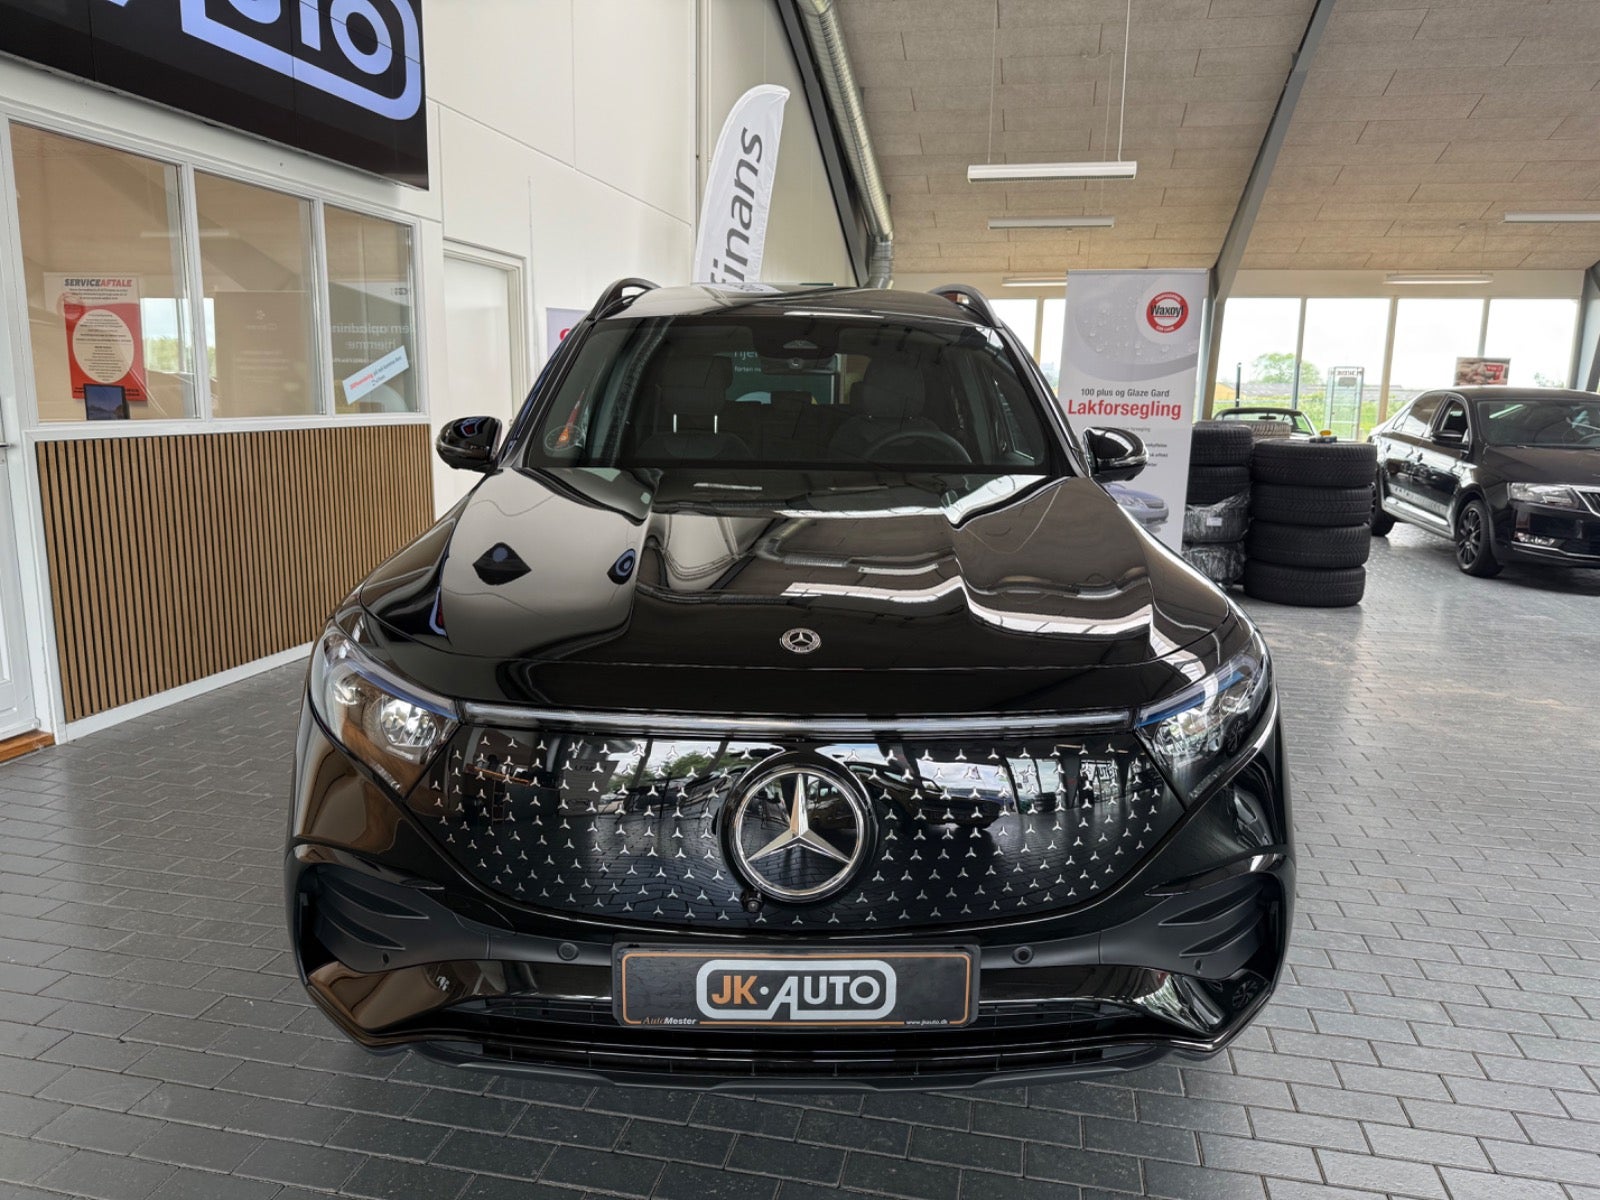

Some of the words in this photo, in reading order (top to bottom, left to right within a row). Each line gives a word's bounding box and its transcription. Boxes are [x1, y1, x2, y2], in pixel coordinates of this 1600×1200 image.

[64, 278, 132, 287] SERVICEAFTALE
[1081, 388, 1095, 396] 100
[1096, 388, 1113, 397] plus
[1127, 388, 1149, 397] Glaze
[1151, 389, 1170, 397] Gard
[1067, 399, 1182, 420] Lakforsegling
